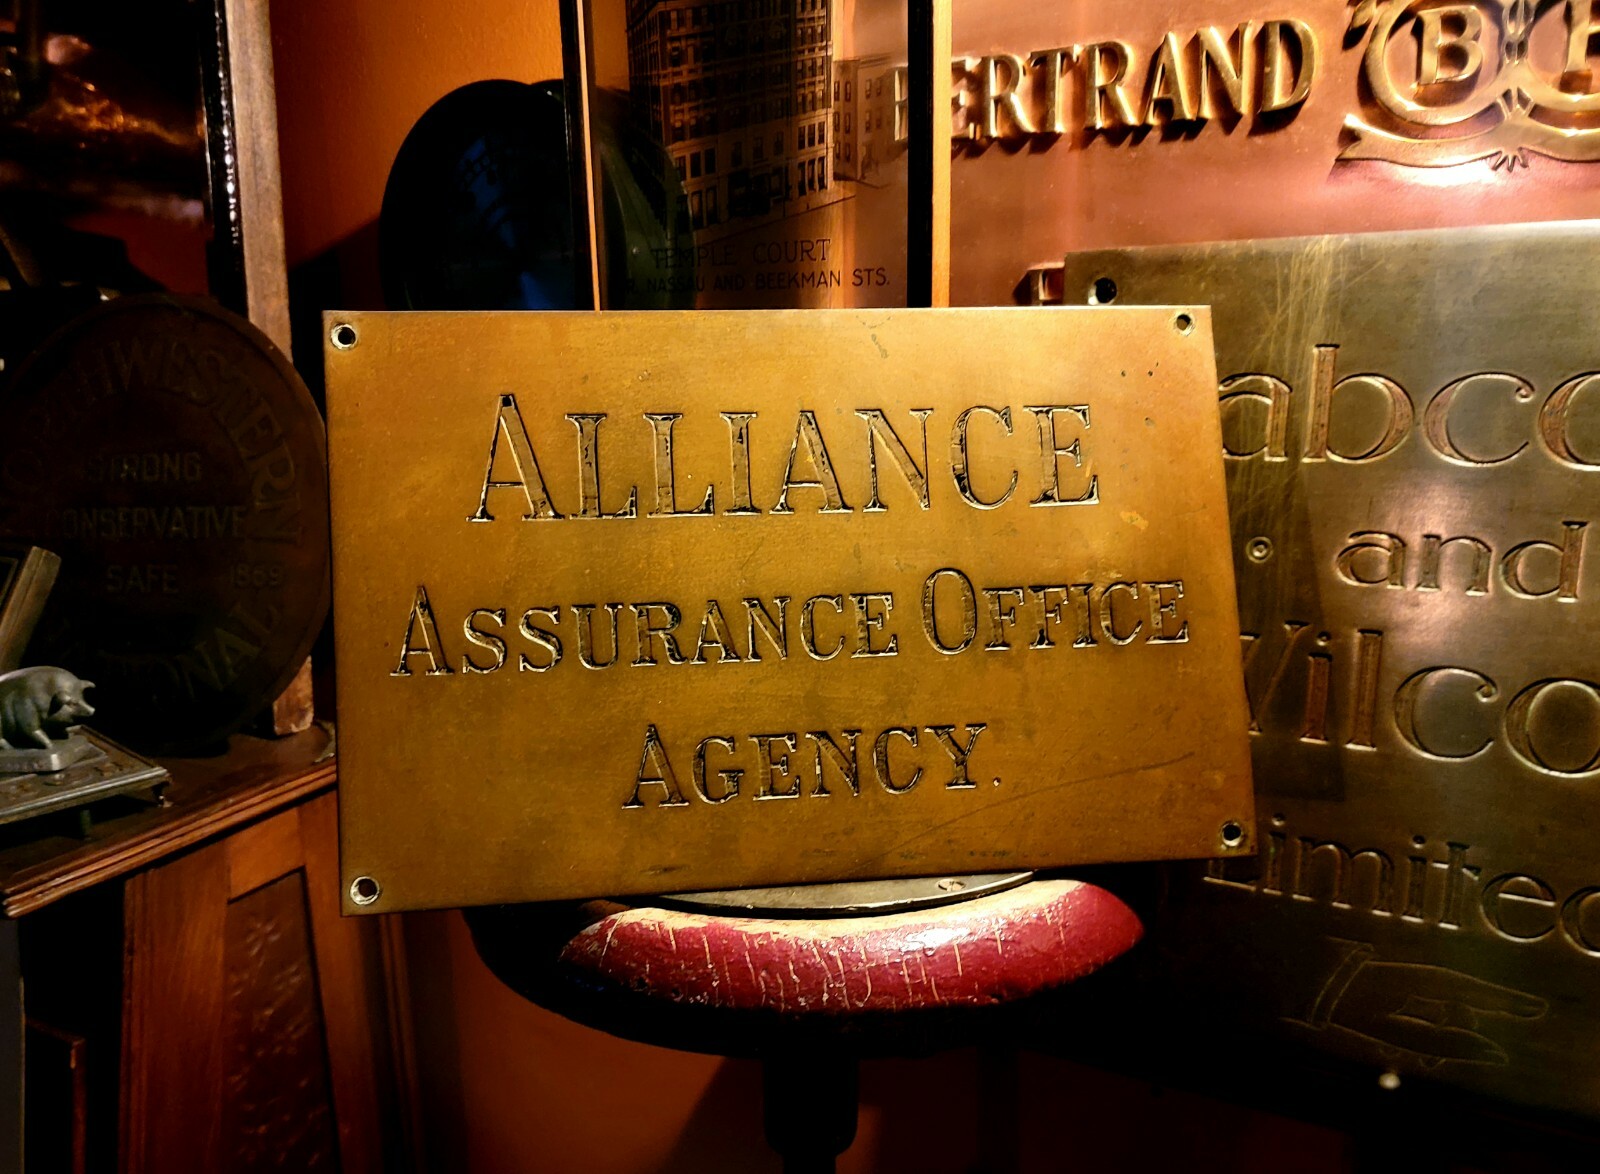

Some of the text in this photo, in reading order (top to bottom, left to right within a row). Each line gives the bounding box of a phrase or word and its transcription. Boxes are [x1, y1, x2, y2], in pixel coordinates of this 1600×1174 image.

[893, 19, 1316, 141] ERTRAND
[647, 273, 706, 293] NASSAU
[713, 273, 746, 292] AND
[755, 270, 842, 291] BEEKMAN
[852, 267, 891, 287] STS.
[651, 238, 832, 269] TEMPLE COURT
[86, 451, 202, 482] STRONG
[466, 393, 1099, 522] ALLIANCE
[105, 564, 180, 595] SAFE
[1335, 521, 1589, 603] and
[389, 567, 1190, 677] ASSURANCE OFFICE
